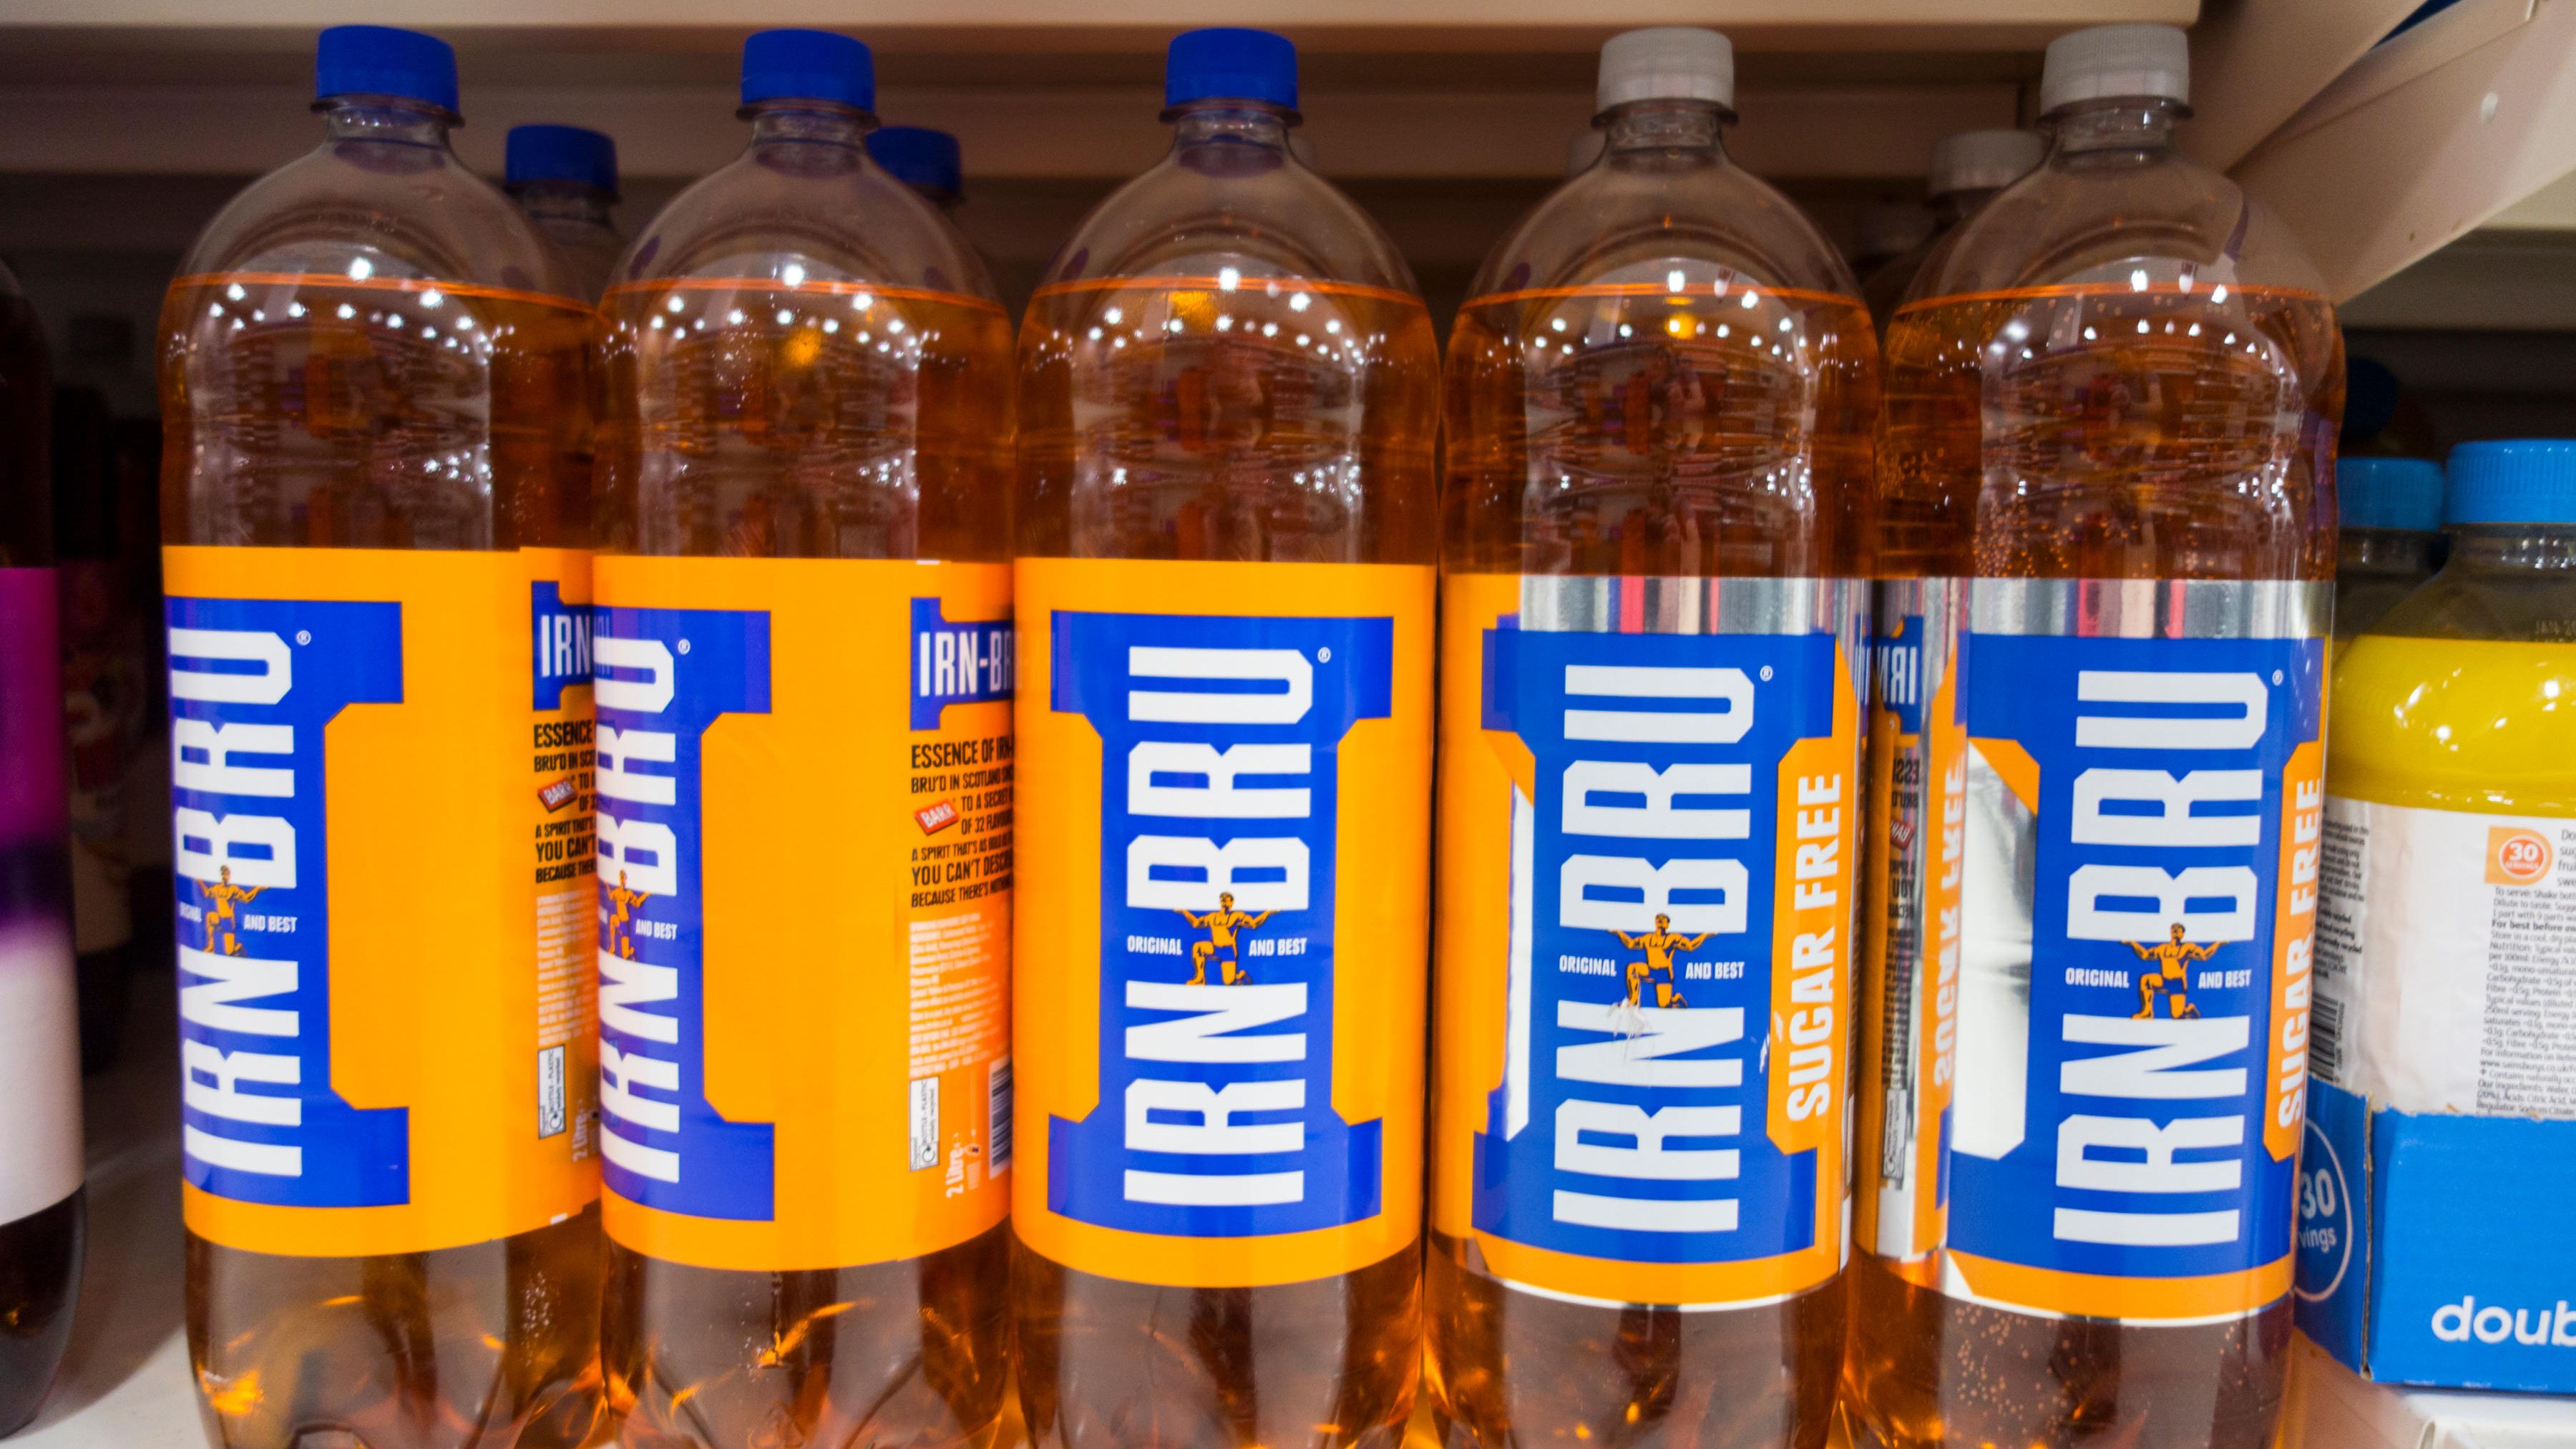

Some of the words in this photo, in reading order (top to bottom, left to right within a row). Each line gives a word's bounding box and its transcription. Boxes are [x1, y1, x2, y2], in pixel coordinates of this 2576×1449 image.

[534, 721, 593, 748] ESSENCE
[167, 627, 296, 889] BRU
[534, 753, 566, 772] BRU'D
[592, 635, 677, 897] BRU
[912, 741, 978, 769] ESSENCE
[981, 738, 994, 763] OF
[911, 774, 947, 794] BRU'D
[950, 774, 960, 790] IN
[962, 767, 1000, 789] SCOTLAND
[1126, 645, 1314, 912] BRU
[961, 795, 973, 812] TO
[1559, 664, 1755, 934] BRU
[2066, 670, 2268, 942] BRU
[961, 818, 972, 836] OF
[975, 816, 985, 834] 32
[536, 839, 563, 863] YOU
[912, 849, 918, 862] A
[921, 844, 950, 862] SPIRIT
[953, 840, 977, 857] THAT'S
[1793, 773, 1841, 910] FREE
[2290, 778, 2321, 916] FREE
[2509, 841, 2539, 862] 30
[536, 863, 577, 884] BECAUSE
[912, 864, 941, 887] YOU
[946, 858, 980, 883] CAN'T
[911, 887, 956, 908] BECAUSE
[958, 882, 989, 901] THERE'S
[243, 914, 267, 933] AND
[268, 915, 298, 934] BEST
[635, 919, 653, 937] AND
[653, 921, 678, 940] BEST
[2492, 919, 2507, 929] For
[2509, 920, 2530, 930] best
[2533, 922, 2563, 932] before
[1127, 935, 1183, 956] ORIGINAL
[1249, 939, 1276, 957] AND
[1277, 937, 1307, 956] BEST
[1558, 955, 1616, 977] ORIGINAL
[1685, 962, 1711, 980] AND
[1714, 960, 1745, 980] BEST
[2065, 967, 2129, 988] ORIGINAL
[2198, 972, 2223, 990] AND
[2225, 970, 2251, 988] BEST
[1786, 925, 1836, 1123] SUGAR
[2278, 933, 2312, 1128] SUGAR
[179, 943, 302, 1178] IRN
[597, 946, 680, 1184] IRN
[1123, 980, 1308, 1207] IRN
[1552, 999, 1745, 1233] IRN
[2052, 1013, 2250, 1246] IRN
[2300, 1169, 2336, 1220] 30
